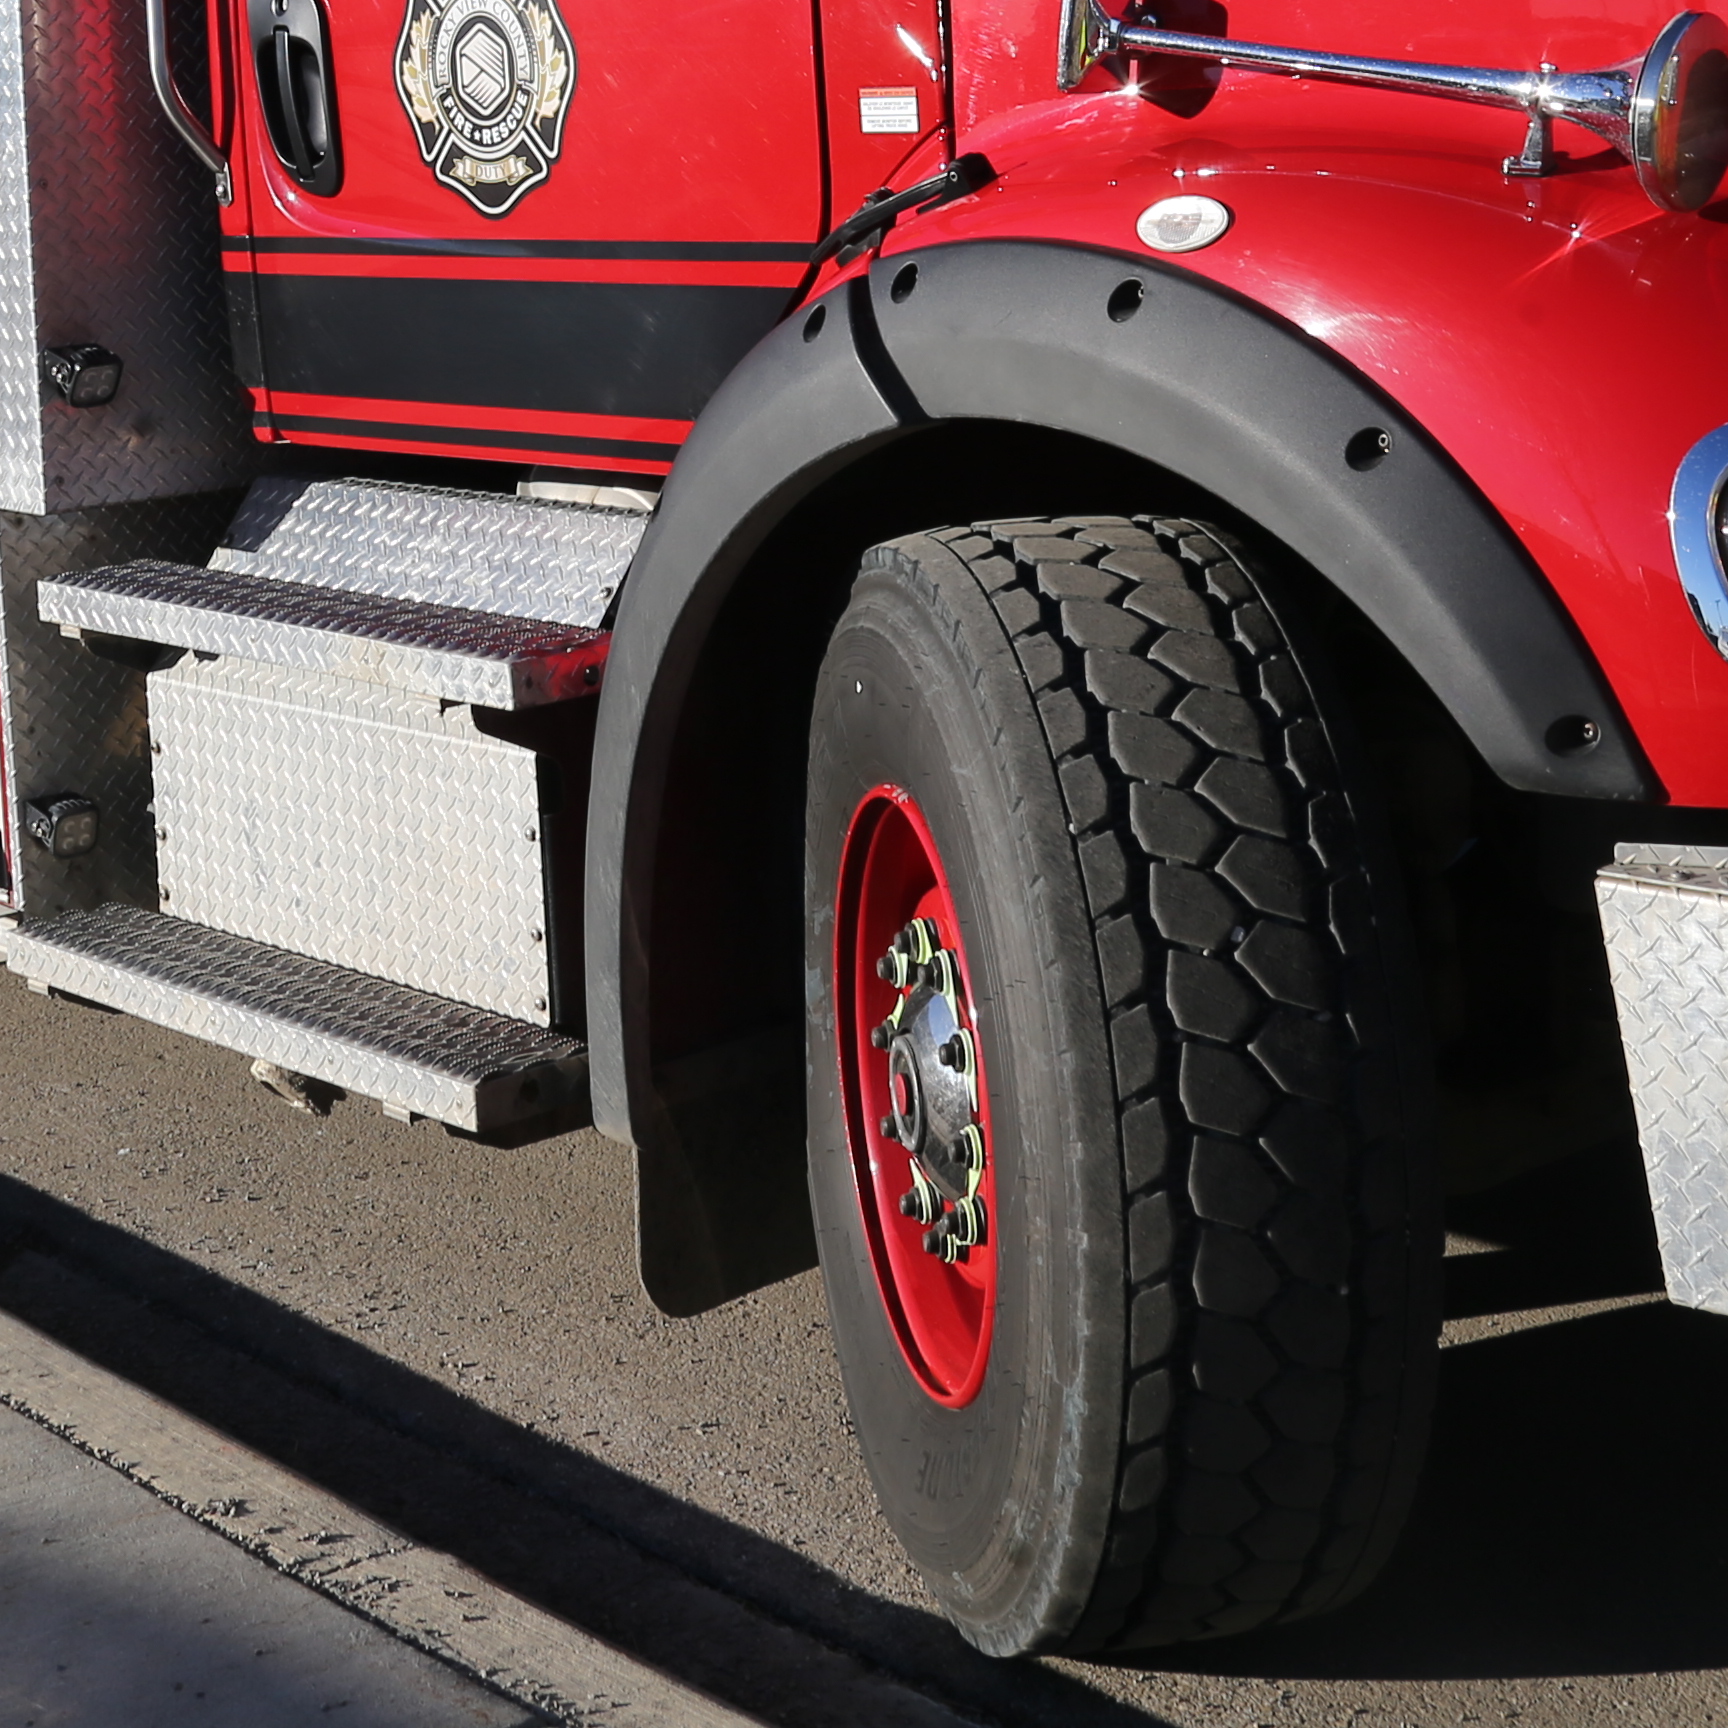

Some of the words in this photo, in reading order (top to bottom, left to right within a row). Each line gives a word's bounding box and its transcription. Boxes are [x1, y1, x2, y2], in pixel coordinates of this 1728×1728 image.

[438, 15, 456, 79] ROCKY
[493, 0, 529, 76] COUNTY
[443, 95, 472, 139] FIRE
[482, 90, 529, 145] RESCUE
[475, 165, 508, 179] DUTY
